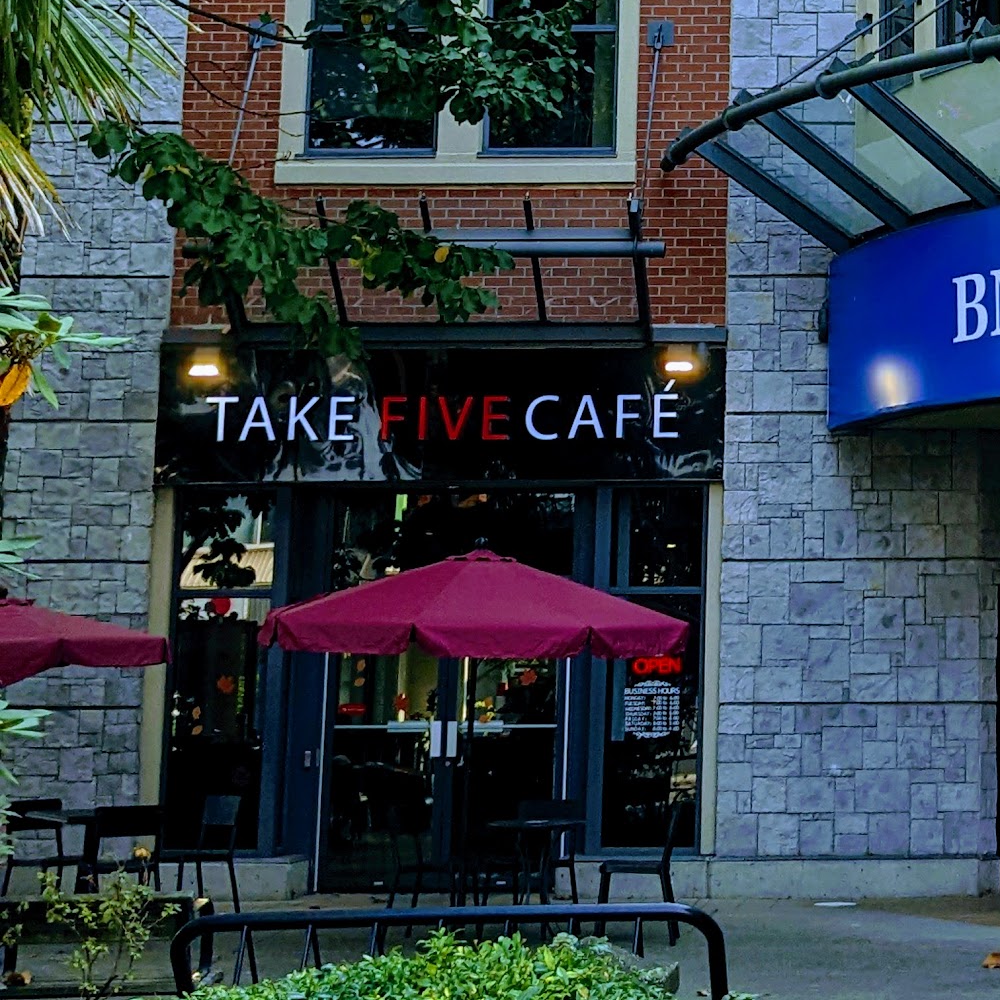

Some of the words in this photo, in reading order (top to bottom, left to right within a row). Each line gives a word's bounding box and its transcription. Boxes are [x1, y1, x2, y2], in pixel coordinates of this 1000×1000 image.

[206, 396, 355, 442] TAKE
[381, 395, 510, 441] FIVE
[525, 379, 680, 440] CAFÉ
[633, 657, 681, 674] OPEN
[624, 687, 657, 695] BUSINESS
